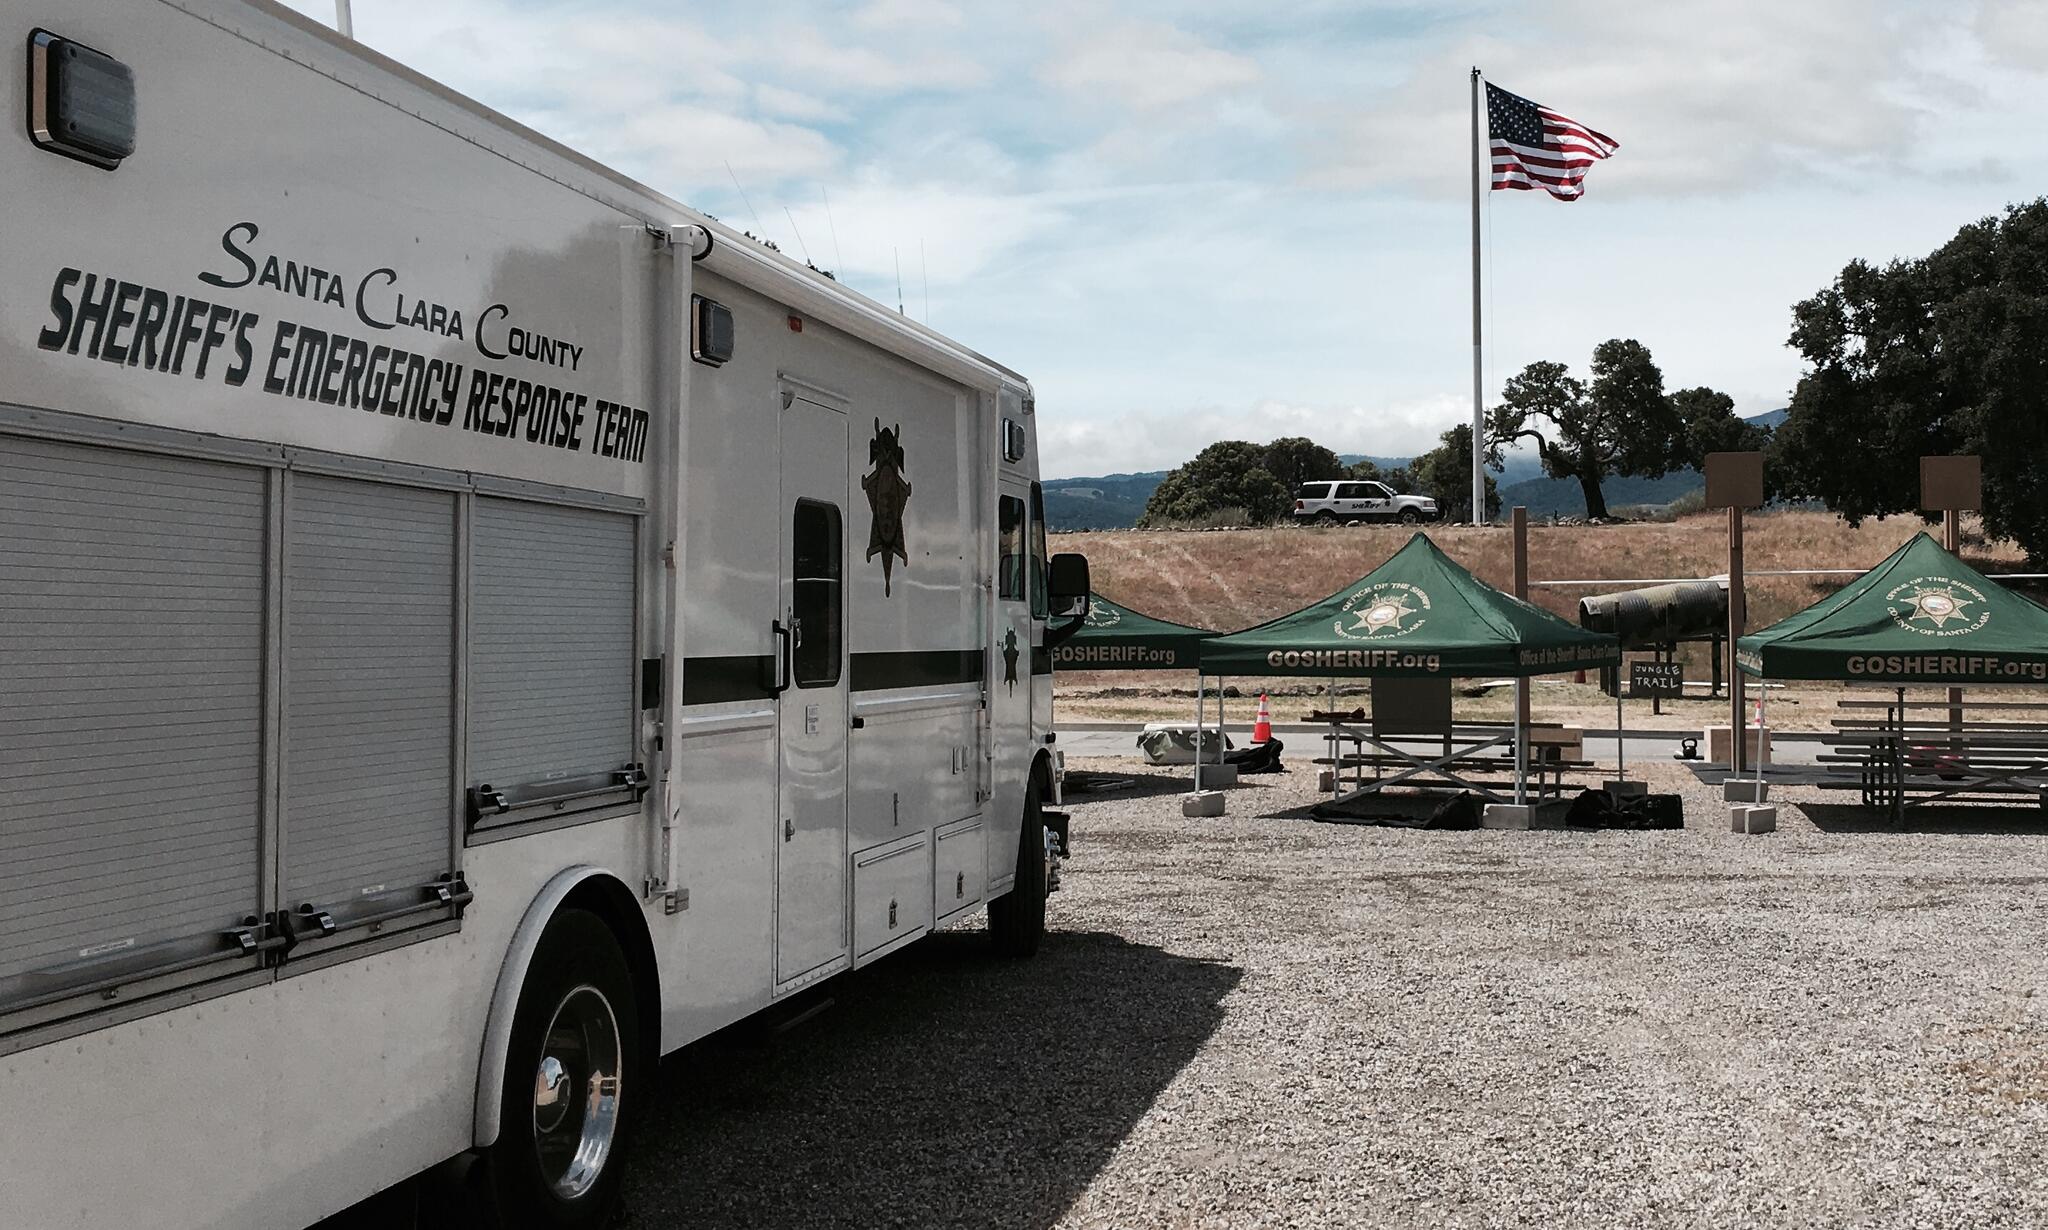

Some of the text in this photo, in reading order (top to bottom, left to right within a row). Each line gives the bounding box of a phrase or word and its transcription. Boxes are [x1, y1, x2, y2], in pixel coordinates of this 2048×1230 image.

[37, 267, 650, 464] SHERIFF'S EMERGENCY RESPONSE TEAM
[1342, 586, 1372, 612] OFFICE
[1374, 582, 1388, 590] OF
[1390, 582, 1410, 590] THE
[1950, 580, 1987, 603] SHERIFF
[1397, 619, 1426, 636] CLARA
[1887, 606, 1918, 633] COUNTY
[1919, 628, 1935, 636] OF
[1936, 628, 1973, 637] SANTA
[1053, 646, 1176, 665] GOSHERIFF.org
[1267, 650, 1440, 672] GOSHERIFF.org
[1635, 665, 1680, 675] JUNGLE
[1846, 656, 2047, 679] GOSHERIFF.org
[1635, 677, 1679, 688] TRAIL
